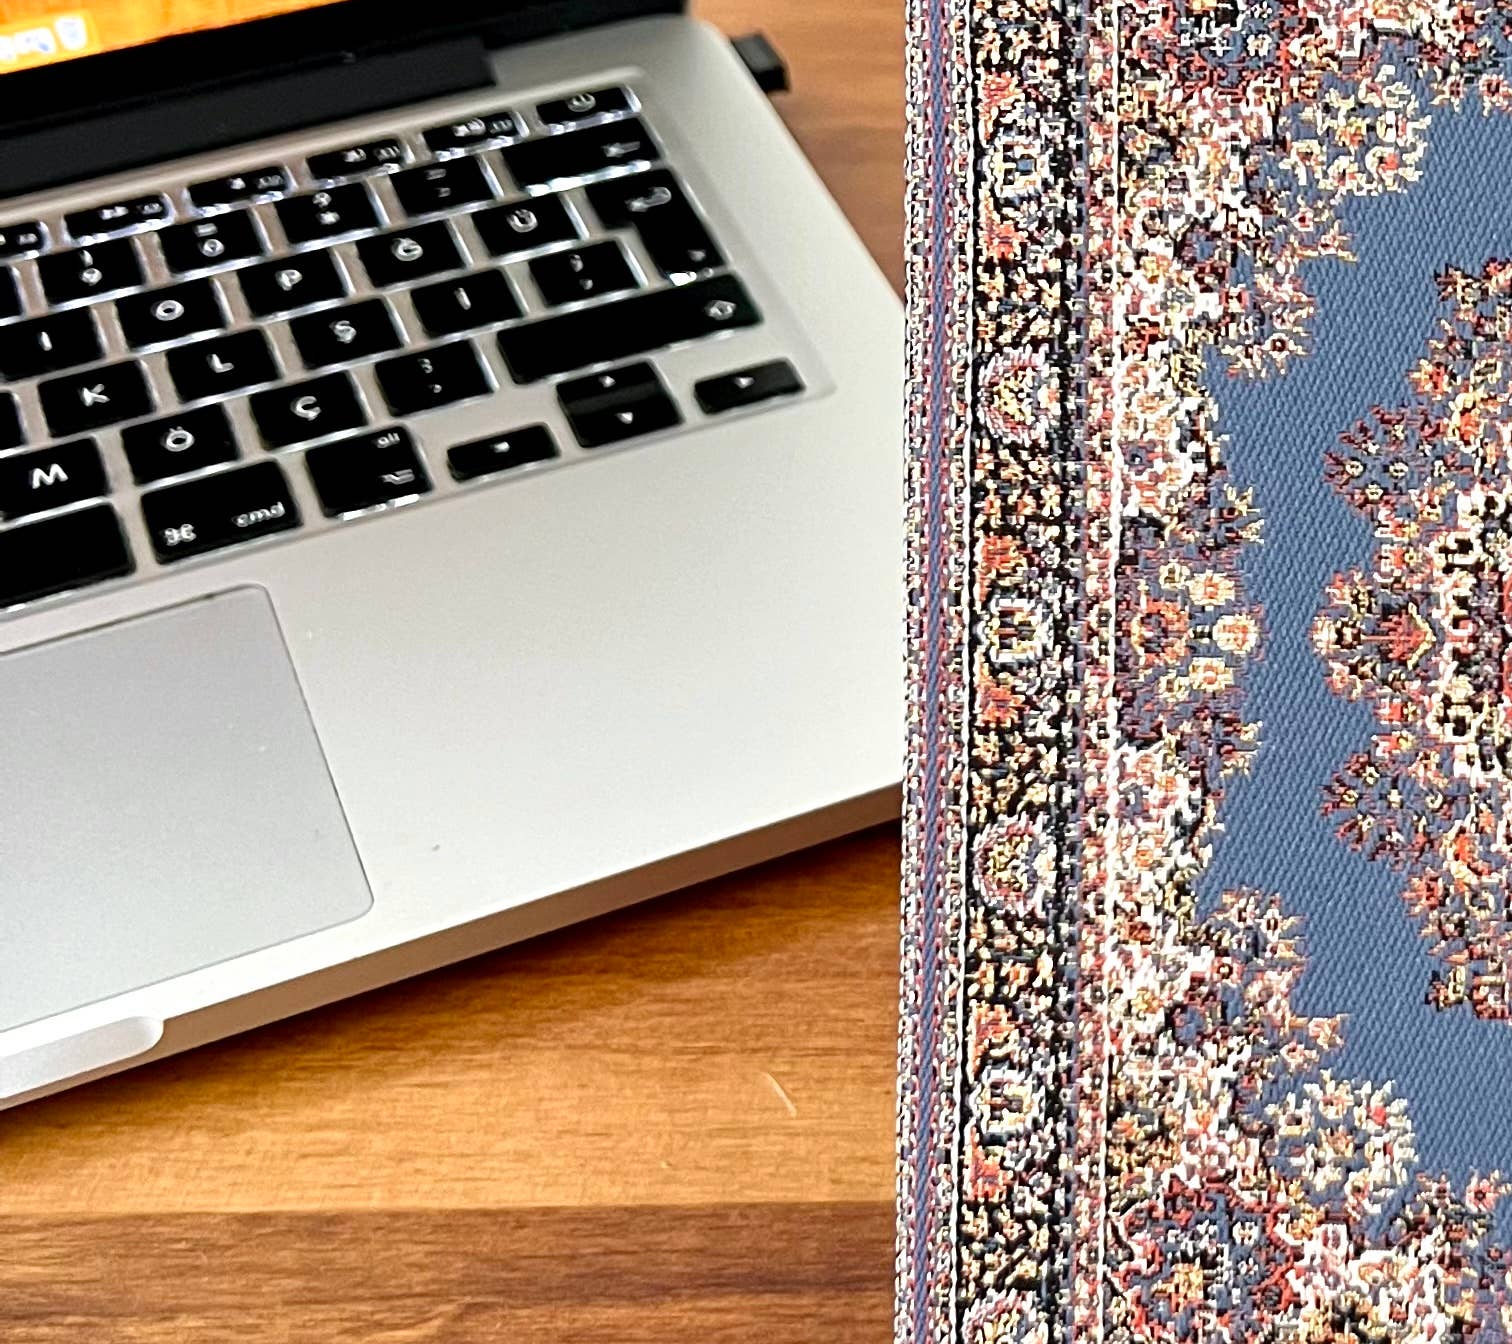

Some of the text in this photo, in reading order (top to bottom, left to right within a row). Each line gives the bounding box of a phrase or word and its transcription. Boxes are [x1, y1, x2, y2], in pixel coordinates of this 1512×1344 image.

[153, 299, 185, 322] O
[207, 353, 235, 374] L
[80, 383, 111, 407] K
[162, 425, 196, 453] Ö
[30, 463, 69, 490] M
[232, 501, 286, 528] cmd
